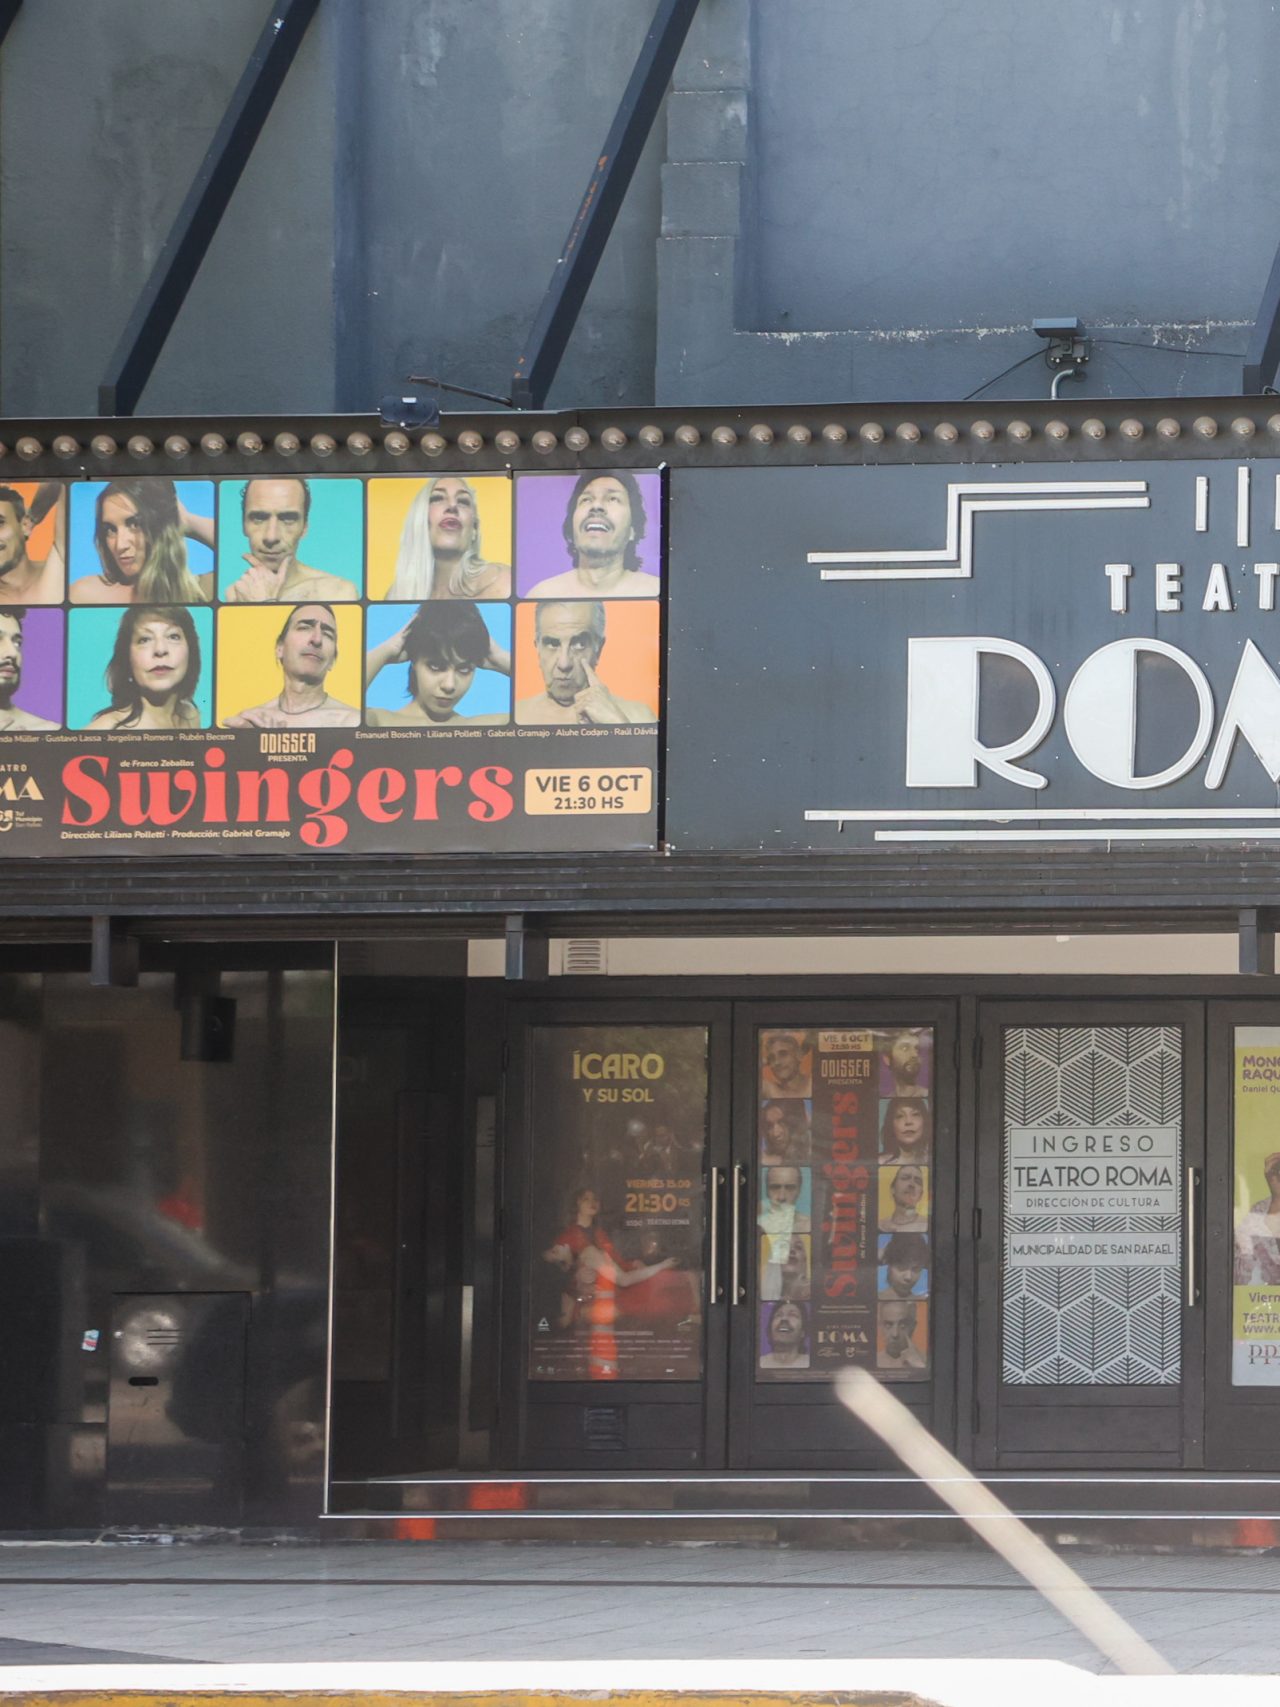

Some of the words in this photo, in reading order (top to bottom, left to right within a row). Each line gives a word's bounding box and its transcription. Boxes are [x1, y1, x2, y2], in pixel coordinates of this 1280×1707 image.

[0, 734, 14, 743] nda
[45, 734, 78, 743] Gustavo
[79, 734, 102, 742] Lassa
[107, 733, 141, 744] Jorgelina
[179, 732, 204, 742] Rubén
[355, 730, 389, 739] Emanuel
[390, 730, 422, 739] Boschin
[427, 730, 452, 739] Liliana
[454, 730, 482, 738] Polletti
[487, 729, 516, 738] Gabriel
[517, 729, 551, 739] Gramajo
[555, 728, 578, 737] Aluhe
[580, 728, 609, 737] Codaro
[614, 727, 631, 736] Raúl
[633, 727, 658, 736] Dávila
[0, 763, 28, 773] ATRO
[120, 759, 130, 768] de
[132, 759, 159, 768] Franco
[160, 759, 195, 768] Zeballos
[0, 776, 45, 801] MA
[536, 775, 571, 793] VIE
[578, 775, 591, 793] 6
[598, 774, 643, 792] OCT
[61, 747, 514, 848] Swingers
[554, 797, 596, 810] 21:30
[601, 796, 624, 809] HS
[61, 830, 103, 840] Dirección:
[104, 830, 132, 839] Liliana
[134, 830, 166, 839] Polletti
[171, 829, 221, 839] Producción:
[222, 829, 253, 838] Gabriel
[255, 829, 290, 839] Gramajo
[849, 1034, 869, 1042] OCT
[572, 1050, 665, 1080] ÍCARO
[583, 1088, 593, 1103] Y
[598, 1088, 619, 1103] SU
[622, 1088, 656, 1103] SOL
[1243, 1085, 1268, 1093] Daniel
[1033, 1134, 1154, 1153] INGRESO
[1013, 1165, 1100, 1187] TEATRO
[1106, 1164, 1173, 1187] ROMA
[822, 1091, 869, 1297] Swingers
[625, 1193, 677, 1213] 21:30
[1026, 1196, 1089, 1208] DIRECCIÓN
[1091, 1197, 1105, 1208] DE
[1108, 1197, 1161, 1208] CULTURA
[1013, 1243, 1092, 1256] MUNICIPALIDAD
[1094, 1243, 1108, 1255] DE
[1110, 1243, 1133, 1255] SAN
[1134, 1243, 1175, 1255] RAFAEL
